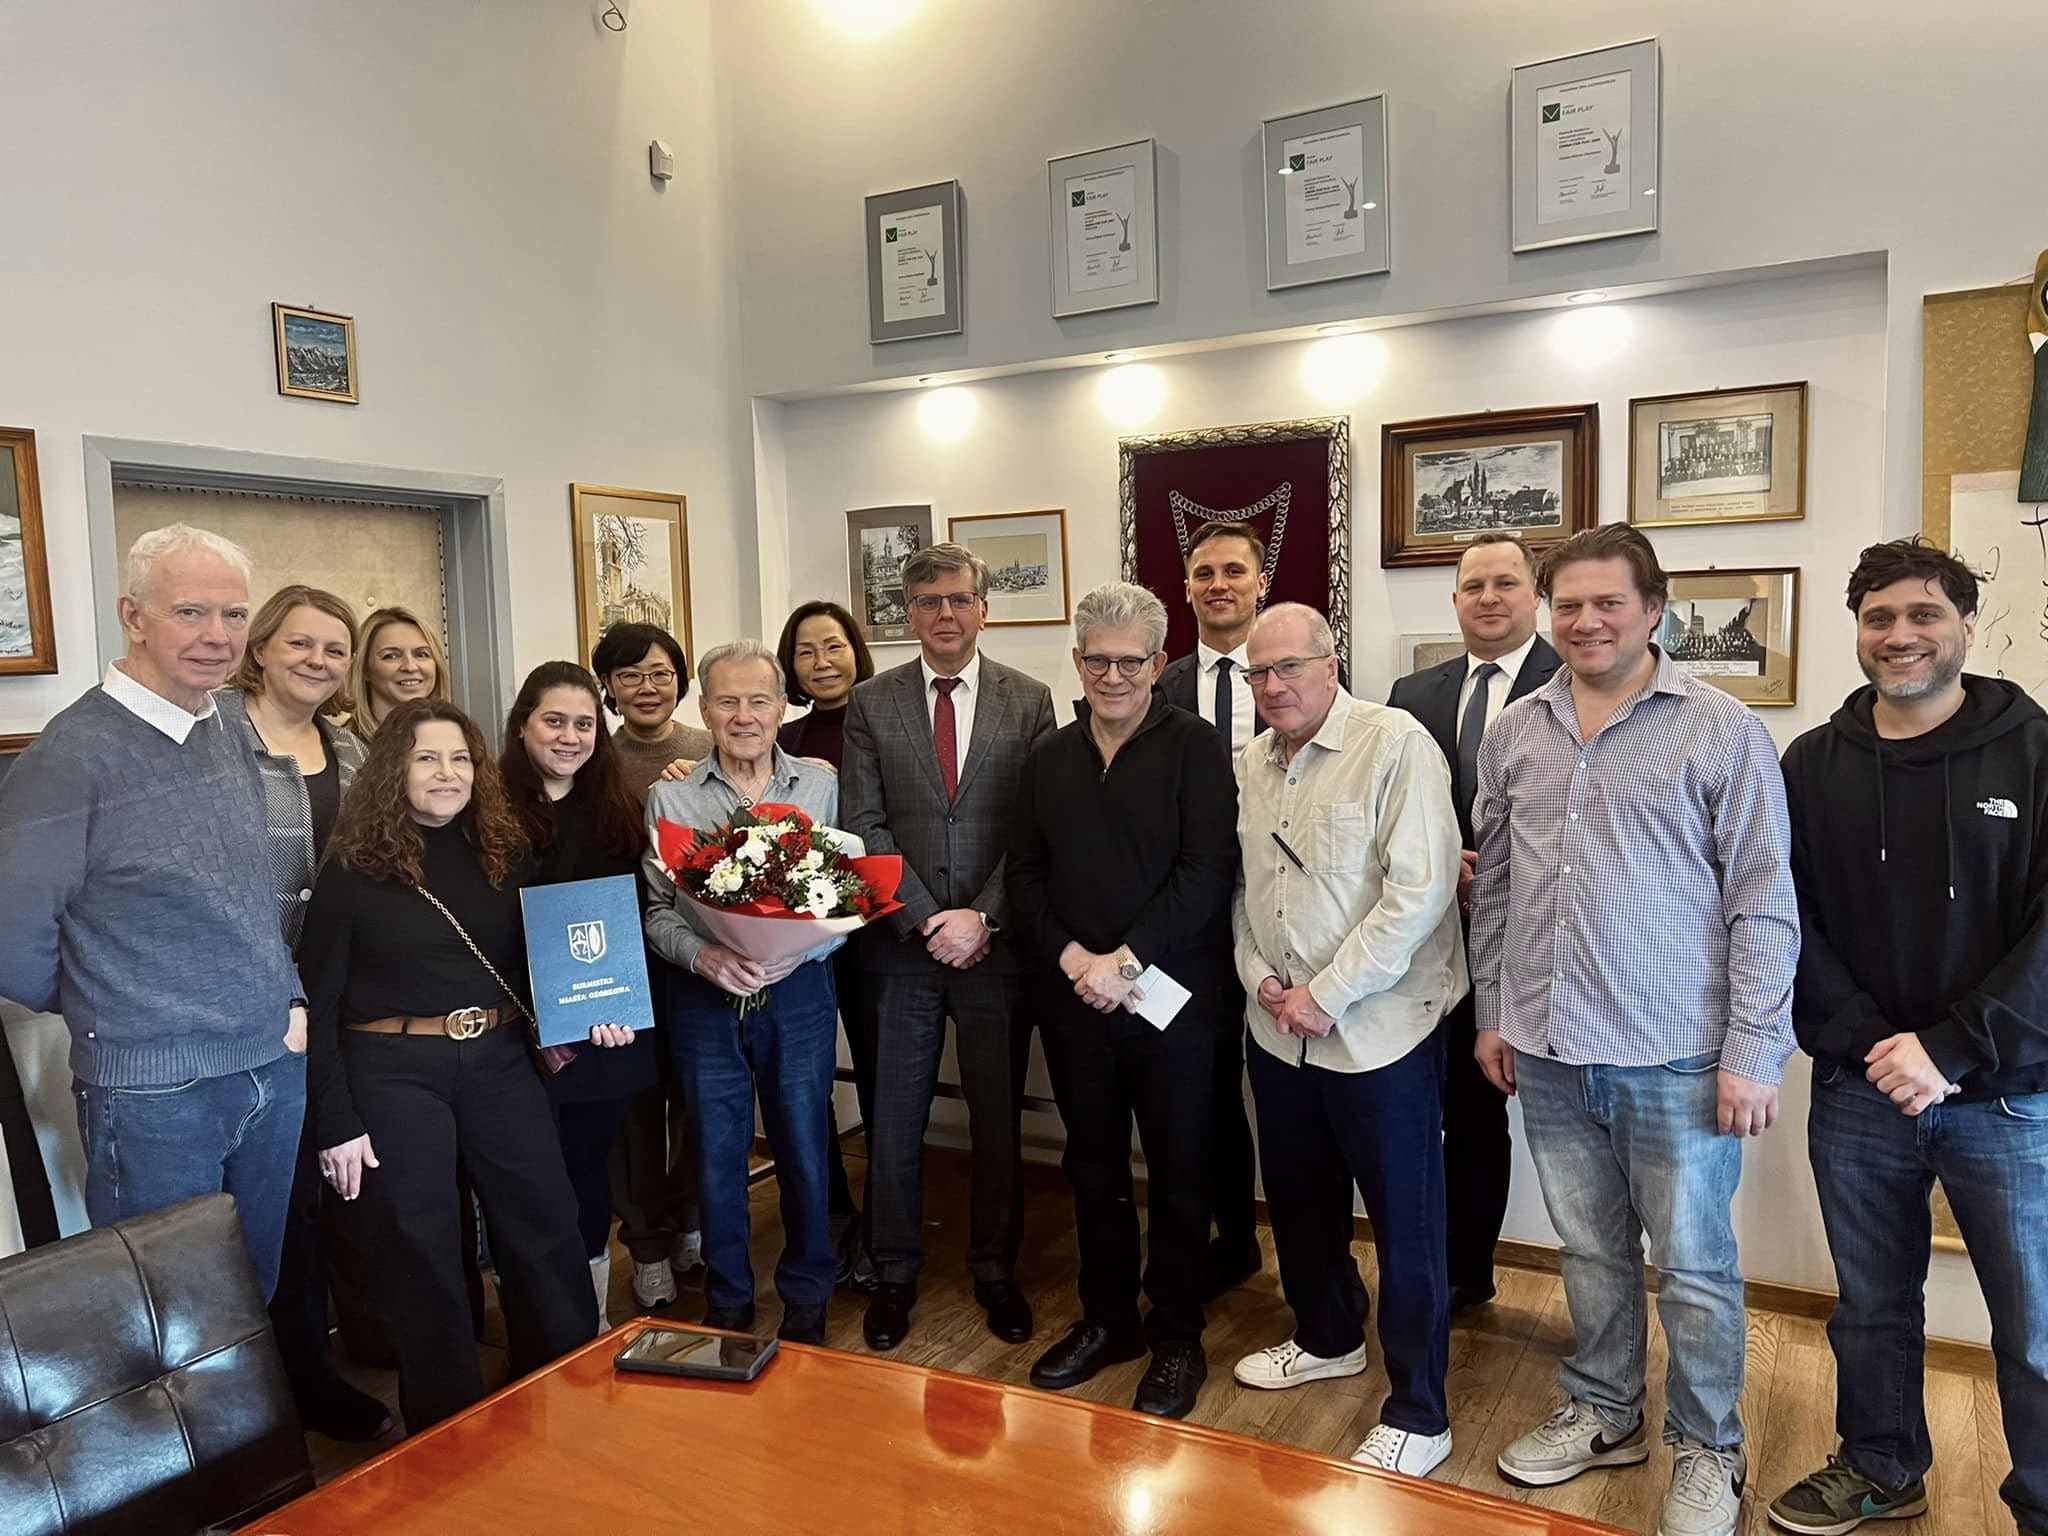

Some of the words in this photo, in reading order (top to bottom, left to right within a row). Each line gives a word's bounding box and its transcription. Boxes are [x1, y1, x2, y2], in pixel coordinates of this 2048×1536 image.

[572, 978, 614, 991] BURMISTRZ
[558, 994, 587, 1004] MIASTA
[588, 986, 630, 999] OZORKOWA
